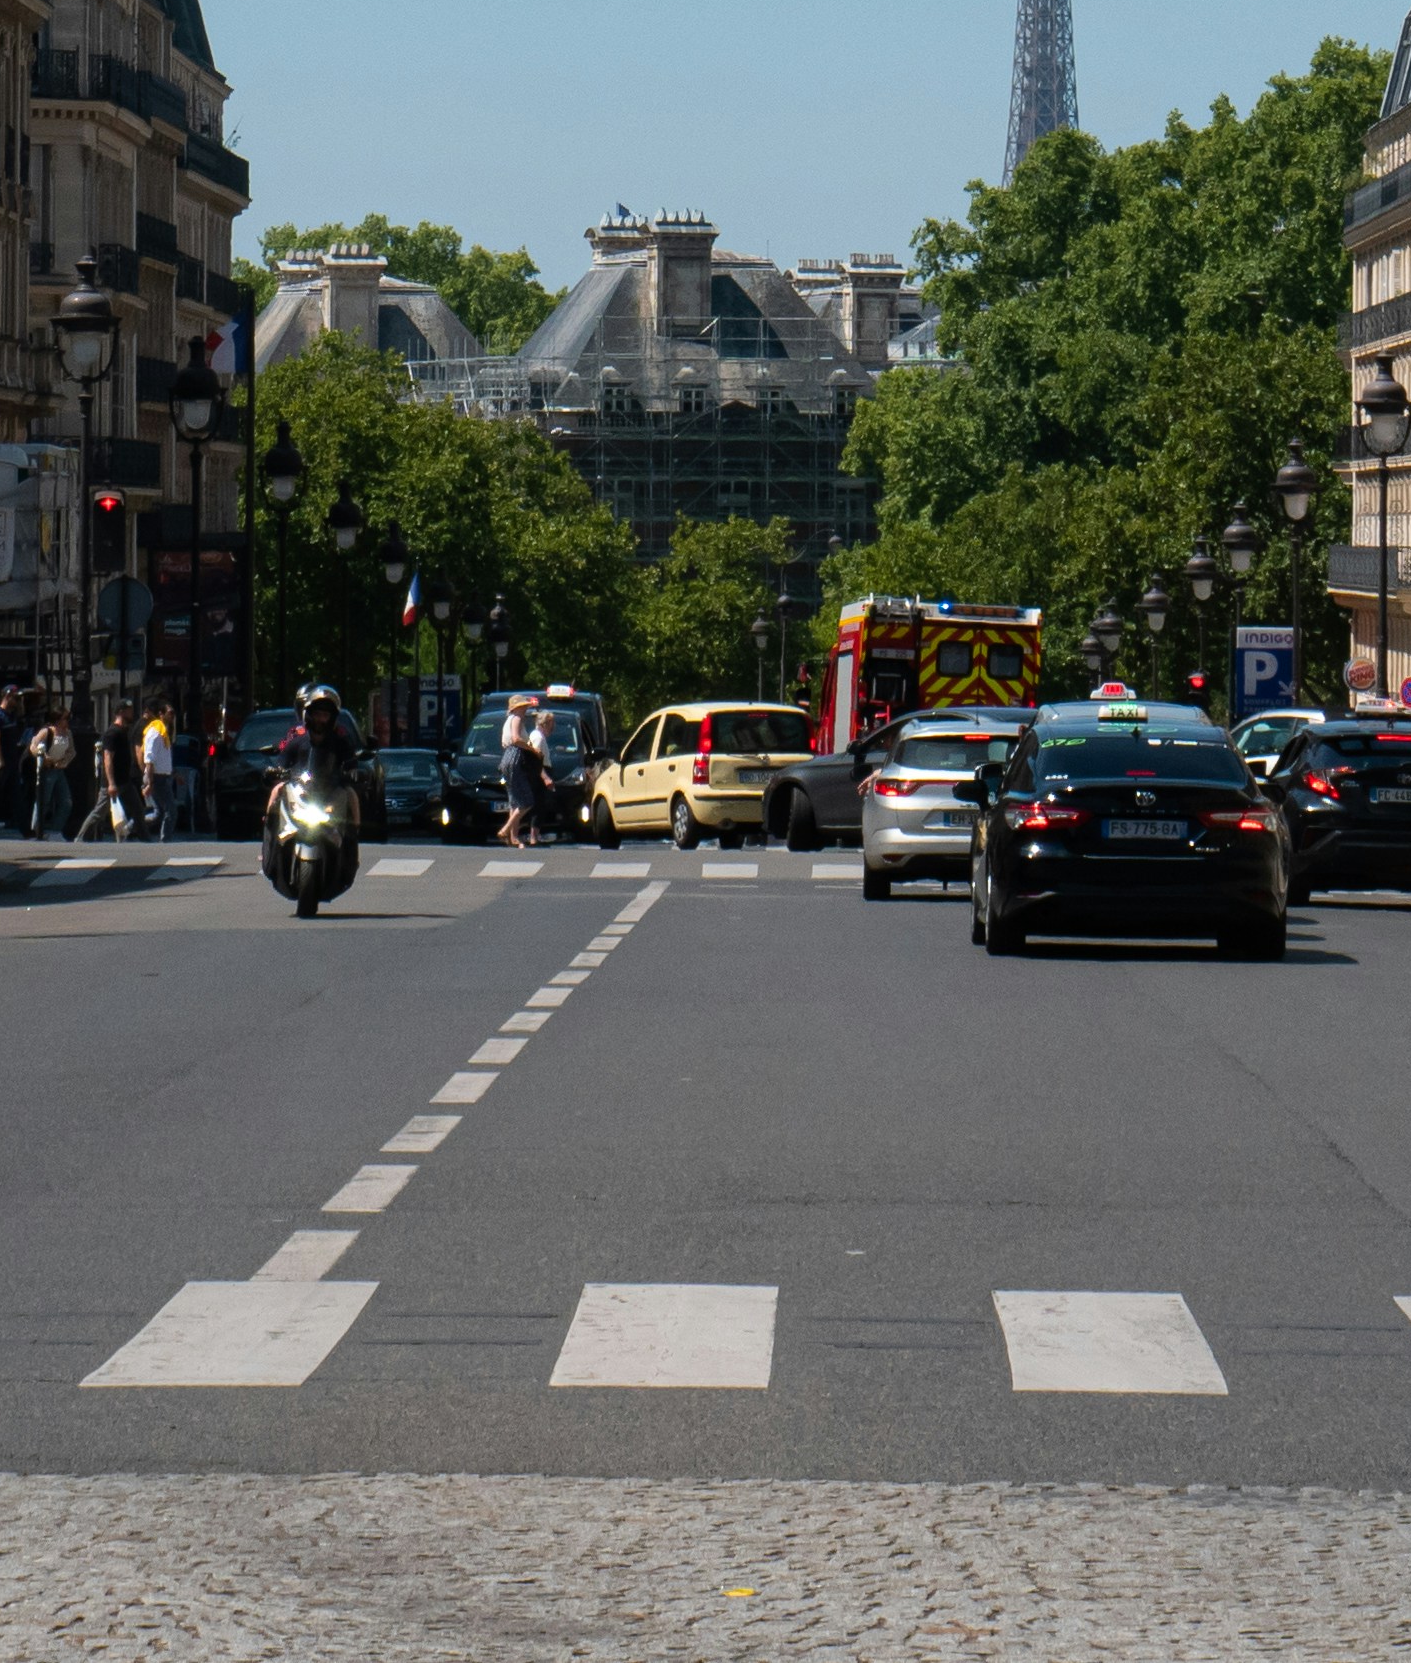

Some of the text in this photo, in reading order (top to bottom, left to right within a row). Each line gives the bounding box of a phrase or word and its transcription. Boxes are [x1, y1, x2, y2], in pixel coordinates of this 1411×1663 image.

[1245, 633, 1294, 645] INDIGO
[1244, 651, 1279, 696] P
[1350, 672, 1376, 684] KING
[1110, 708, 1139, 718] TAXI
[1110, 821, 1179, 834] FS-775-GA
